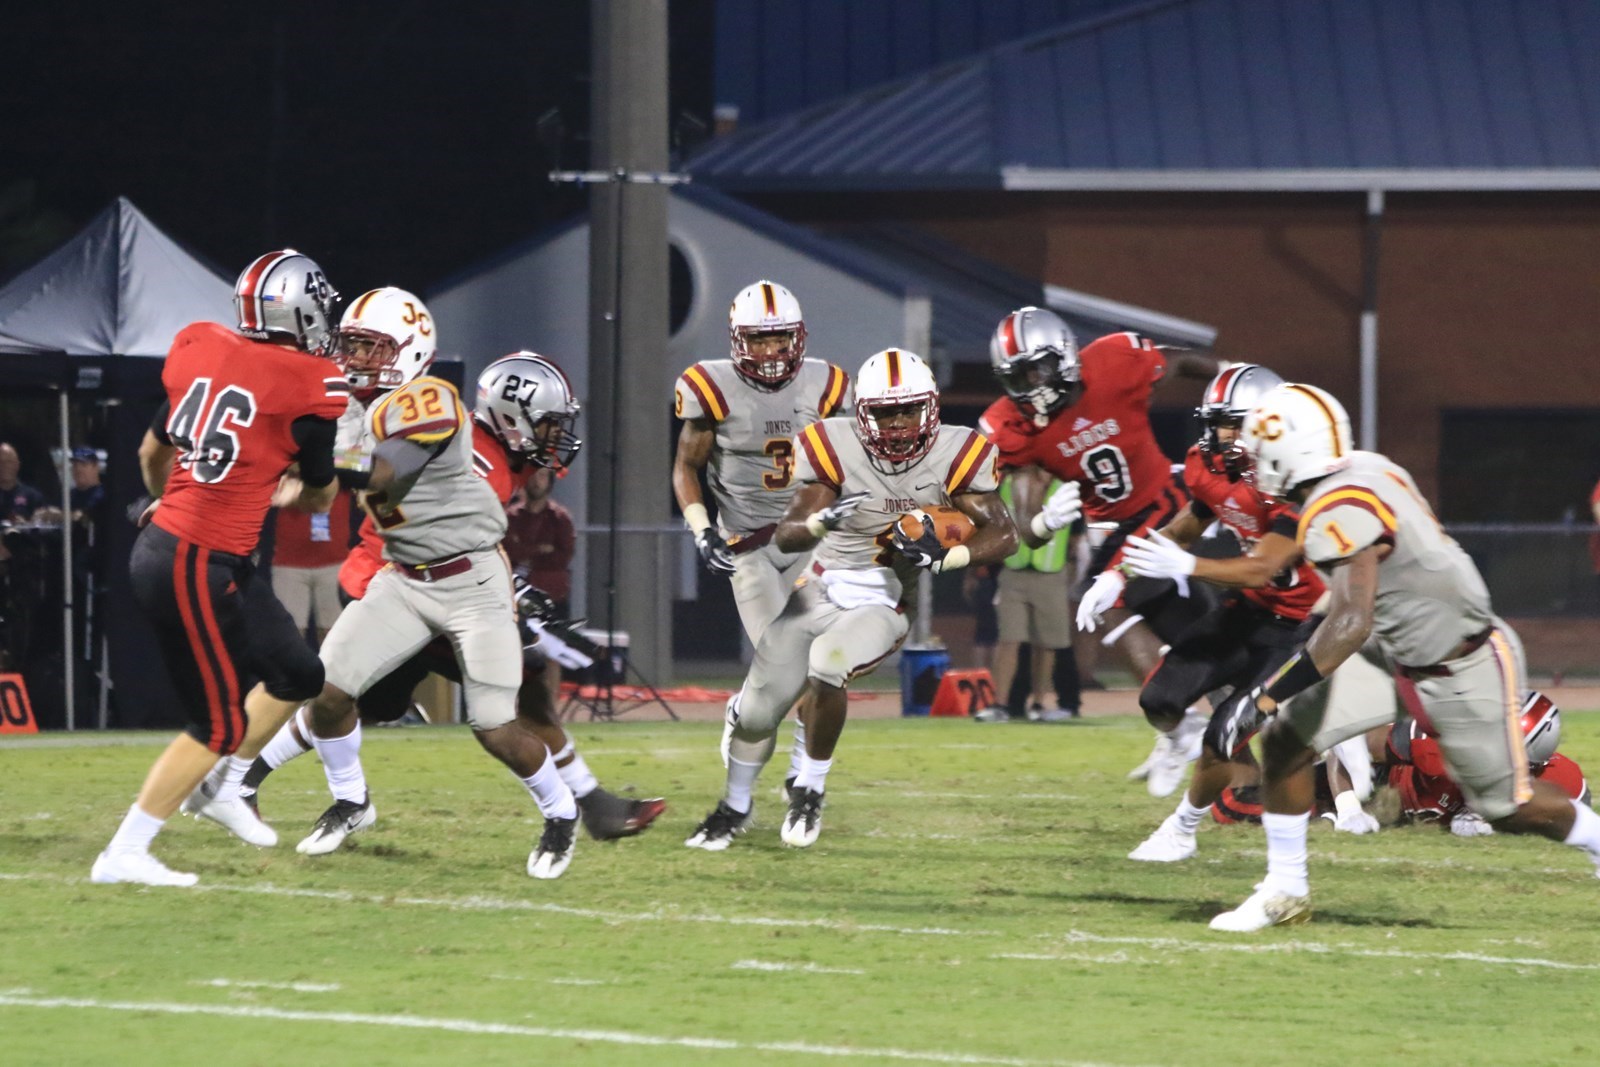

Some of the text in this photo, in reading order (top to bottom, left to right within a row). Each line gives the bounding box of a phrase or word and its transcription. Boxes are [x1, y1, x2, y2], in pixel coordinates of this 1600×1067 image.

[402, 301, 432, 337] JC
[395, 387, 443, 422] 32
[501, 374, 539, 408] 27
[166, 377, 257, 484] 46
[764, 420, 792, 434] JONES
[1056, 418, 1121, 457] LIONS
[762, 437, 793, 490] 3
[1079, 443, 1134, 503] 9
[882, 498, 917, 512] JONES
[1324, 519, 1354, 556] 1
[0, 680, 28, 726] 0
